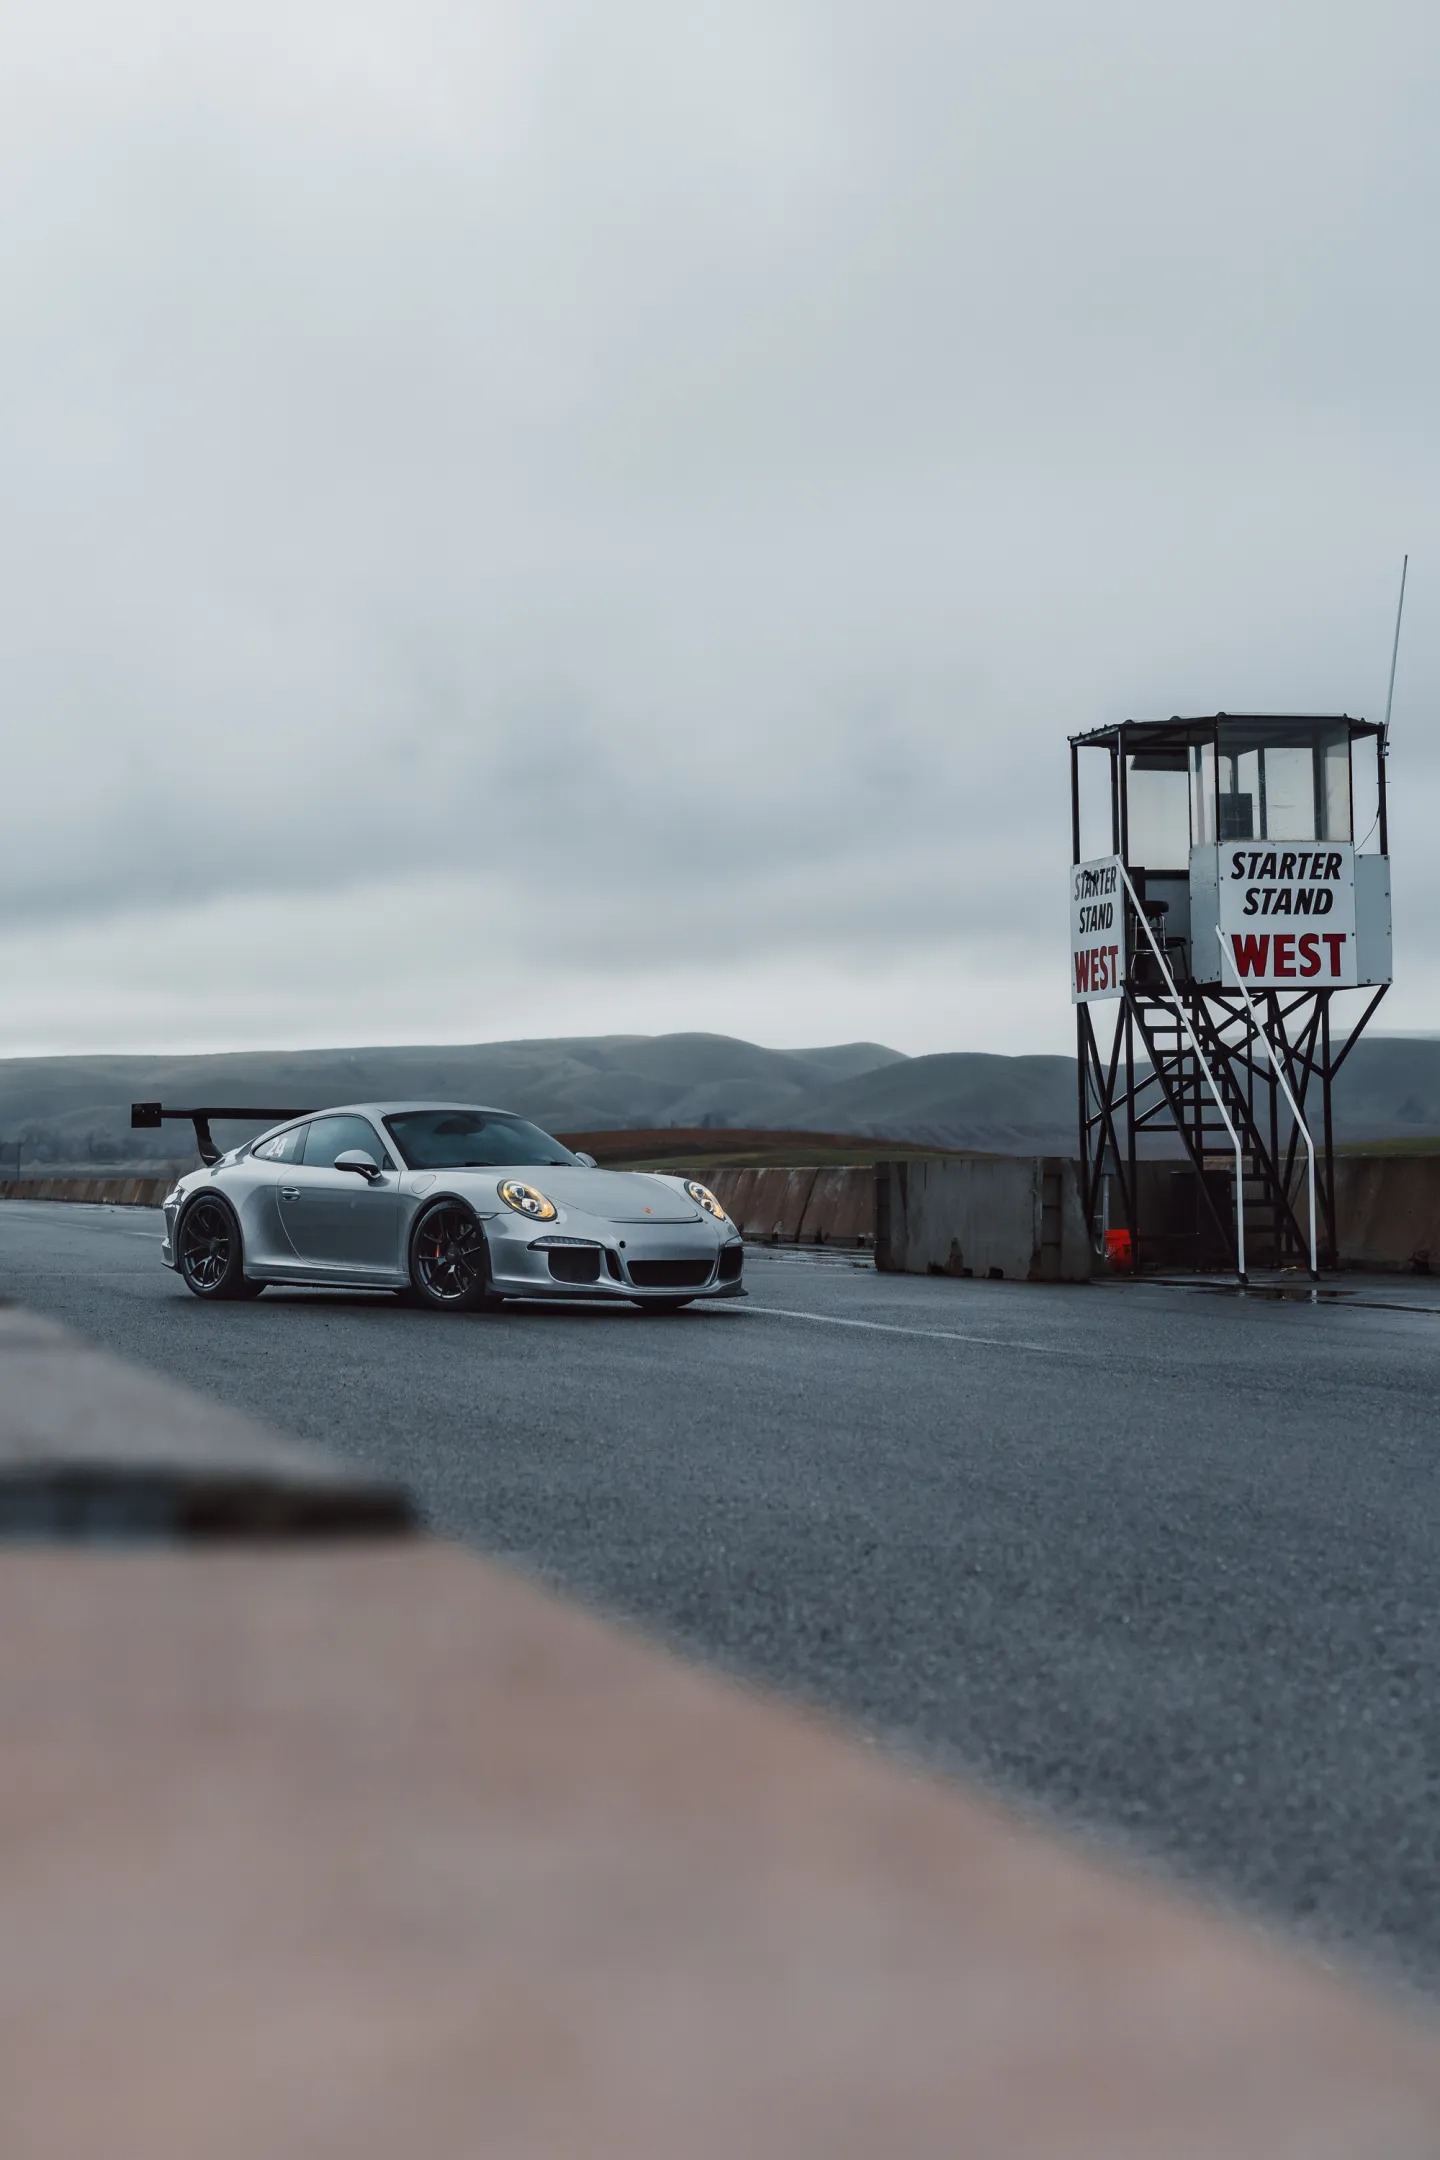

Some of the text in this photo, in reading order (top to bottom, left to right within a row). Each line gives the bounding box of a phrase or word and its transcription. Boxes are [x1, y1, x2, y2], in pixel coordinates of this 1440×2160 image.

[1231, 852, 1342, 880] STARTER
[1074, 866, 1116, 901] STARTER
[1243, 888, 1333, 915] STAND
[1079, 902, 1113, 934] STAND
[1074, 945, 1118, 993] WEST
[1231, 933, 1346, 977] WEST
[266, 1137, 288, 1157] 24
